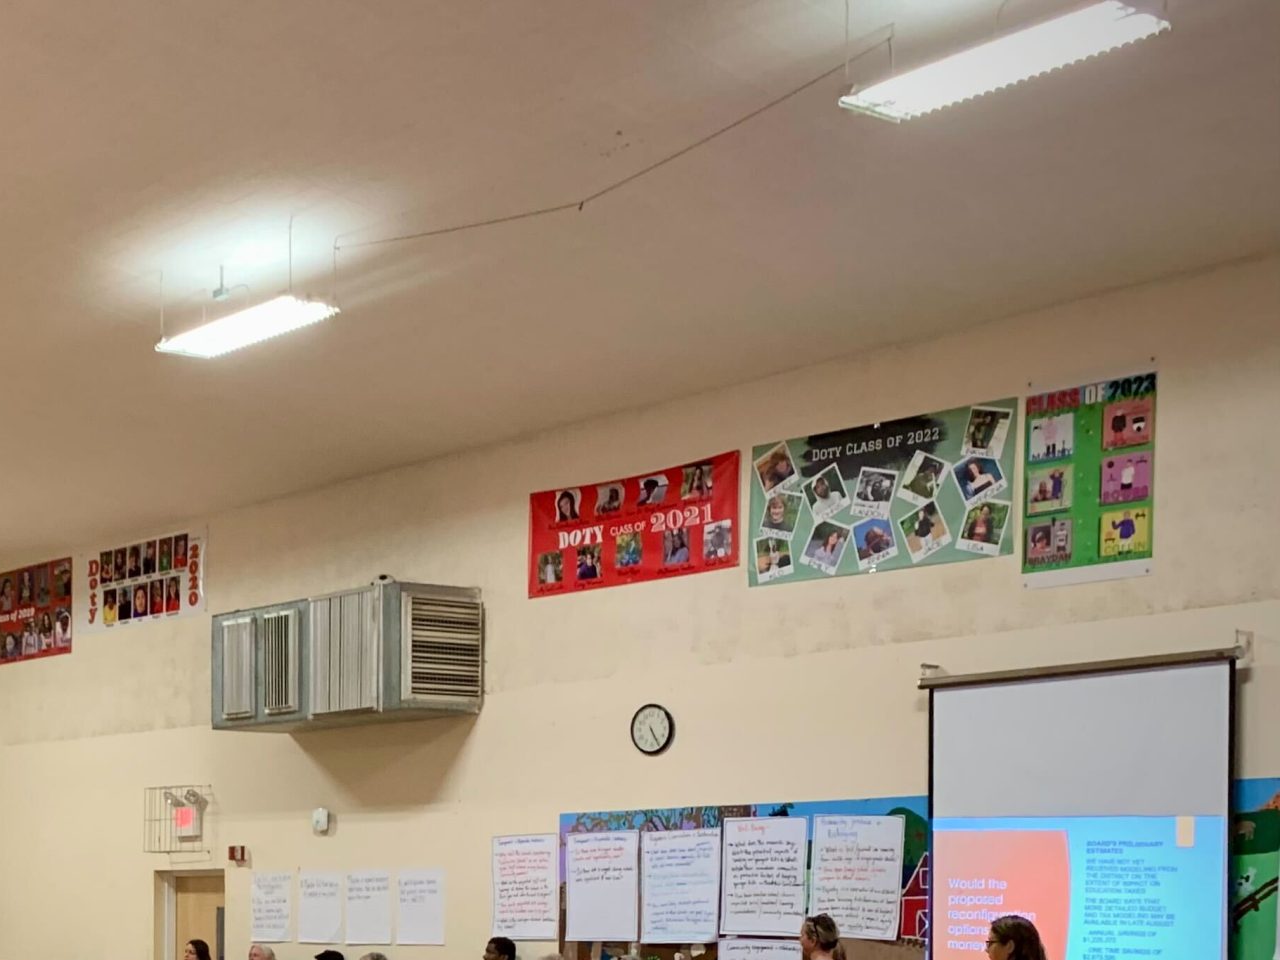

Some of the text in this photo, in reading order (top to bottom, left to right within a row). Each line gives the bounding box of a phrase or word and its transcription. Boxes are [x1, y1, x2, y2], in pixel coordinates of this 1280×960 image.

[1026, 373, 1157, 415] CLASS OF 2023
[812, 427, 940, 461] DOTY CLASS OF 2022
[559, 504, 713, 549] DOTY CLASS OF 2021
[188, 544, 200, 606] 2020
[948, 879, 1007, 889] Would the
[948, 894, 1003, 906] proposed
